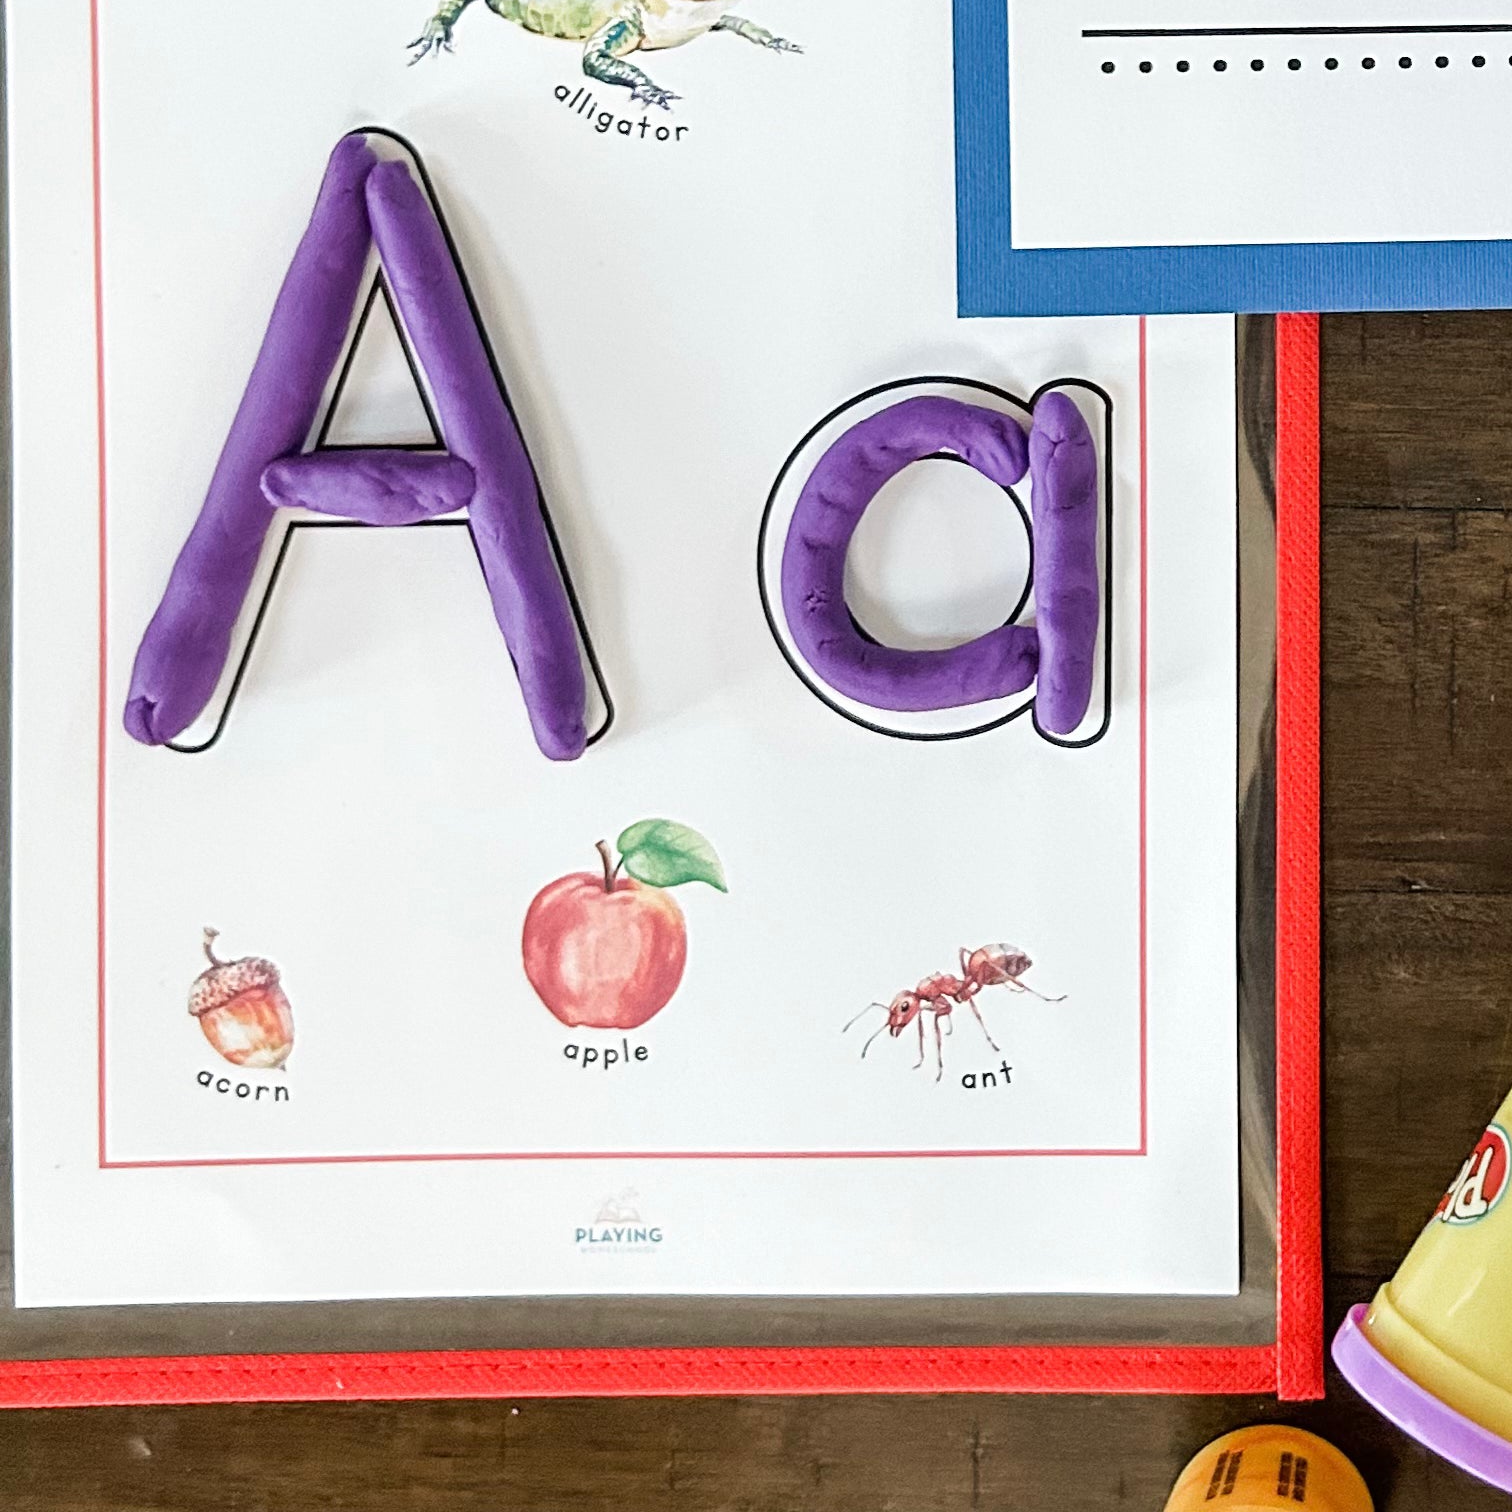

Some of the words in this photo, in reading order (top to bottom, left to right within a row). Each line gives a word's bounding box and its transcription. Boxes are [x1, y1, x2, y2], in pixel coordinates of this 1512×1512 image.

[554, 85, 690, 141] alligator
[563, 1038, 649, 1071] apple
[196, 1070, 290, 1102] acorn
[961, 1059, 1013, 1089] ant
[575, 1227, 663, 1243] PLAYING
